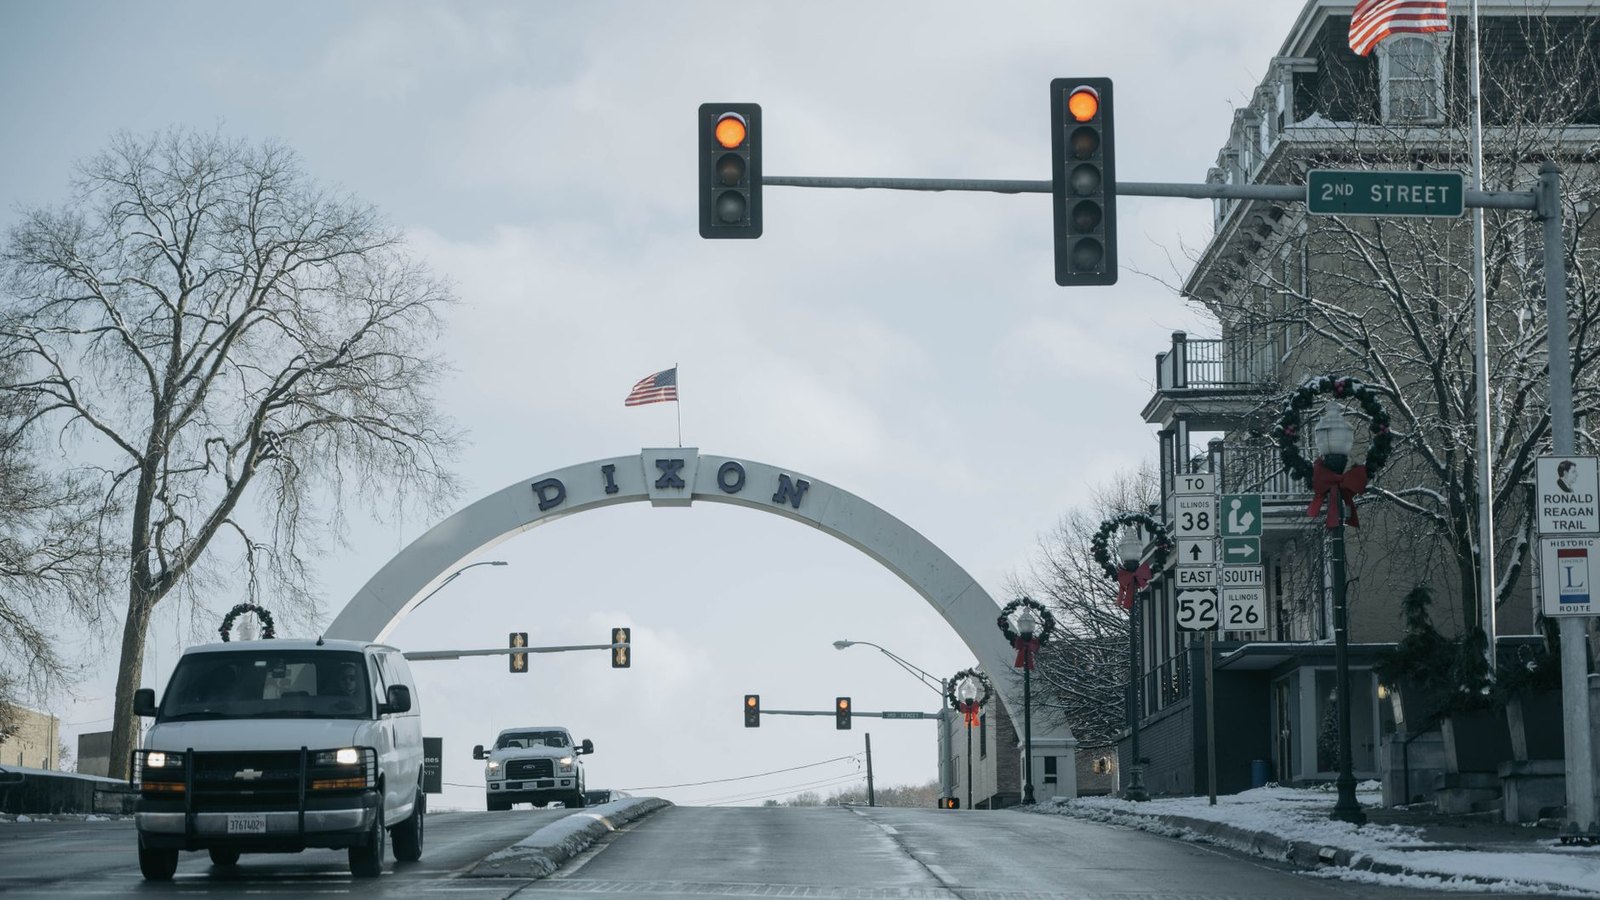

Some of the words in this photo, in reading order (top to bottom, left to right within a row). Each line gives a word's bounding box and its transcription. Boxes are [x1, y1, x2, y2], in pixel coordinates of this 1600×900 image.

[1321, 183, 1354, 201] 2ND
[1370, 184, 1449, 204] STREET
[531, 459, 811, 512] DIXON
[1185, 478, 1204, 490] TO
[1180, 501, 1210, 509] ILLINOIS
[1544, 494, 1593, 504] RONALD
[1544, 507, 1594, 517] REAGAN
[1181, 512, 1210, 531] 38
[1552, 520, 1587, 530] TRAIL
[1180, 571, 1213, 583] EAST
[1224, 570, 1262, 582] SOUTH
[1563, 566, 1584, 588] L
[1180, 599, 1215, 622] 52
[1229, 604, 1259, 624] 26
